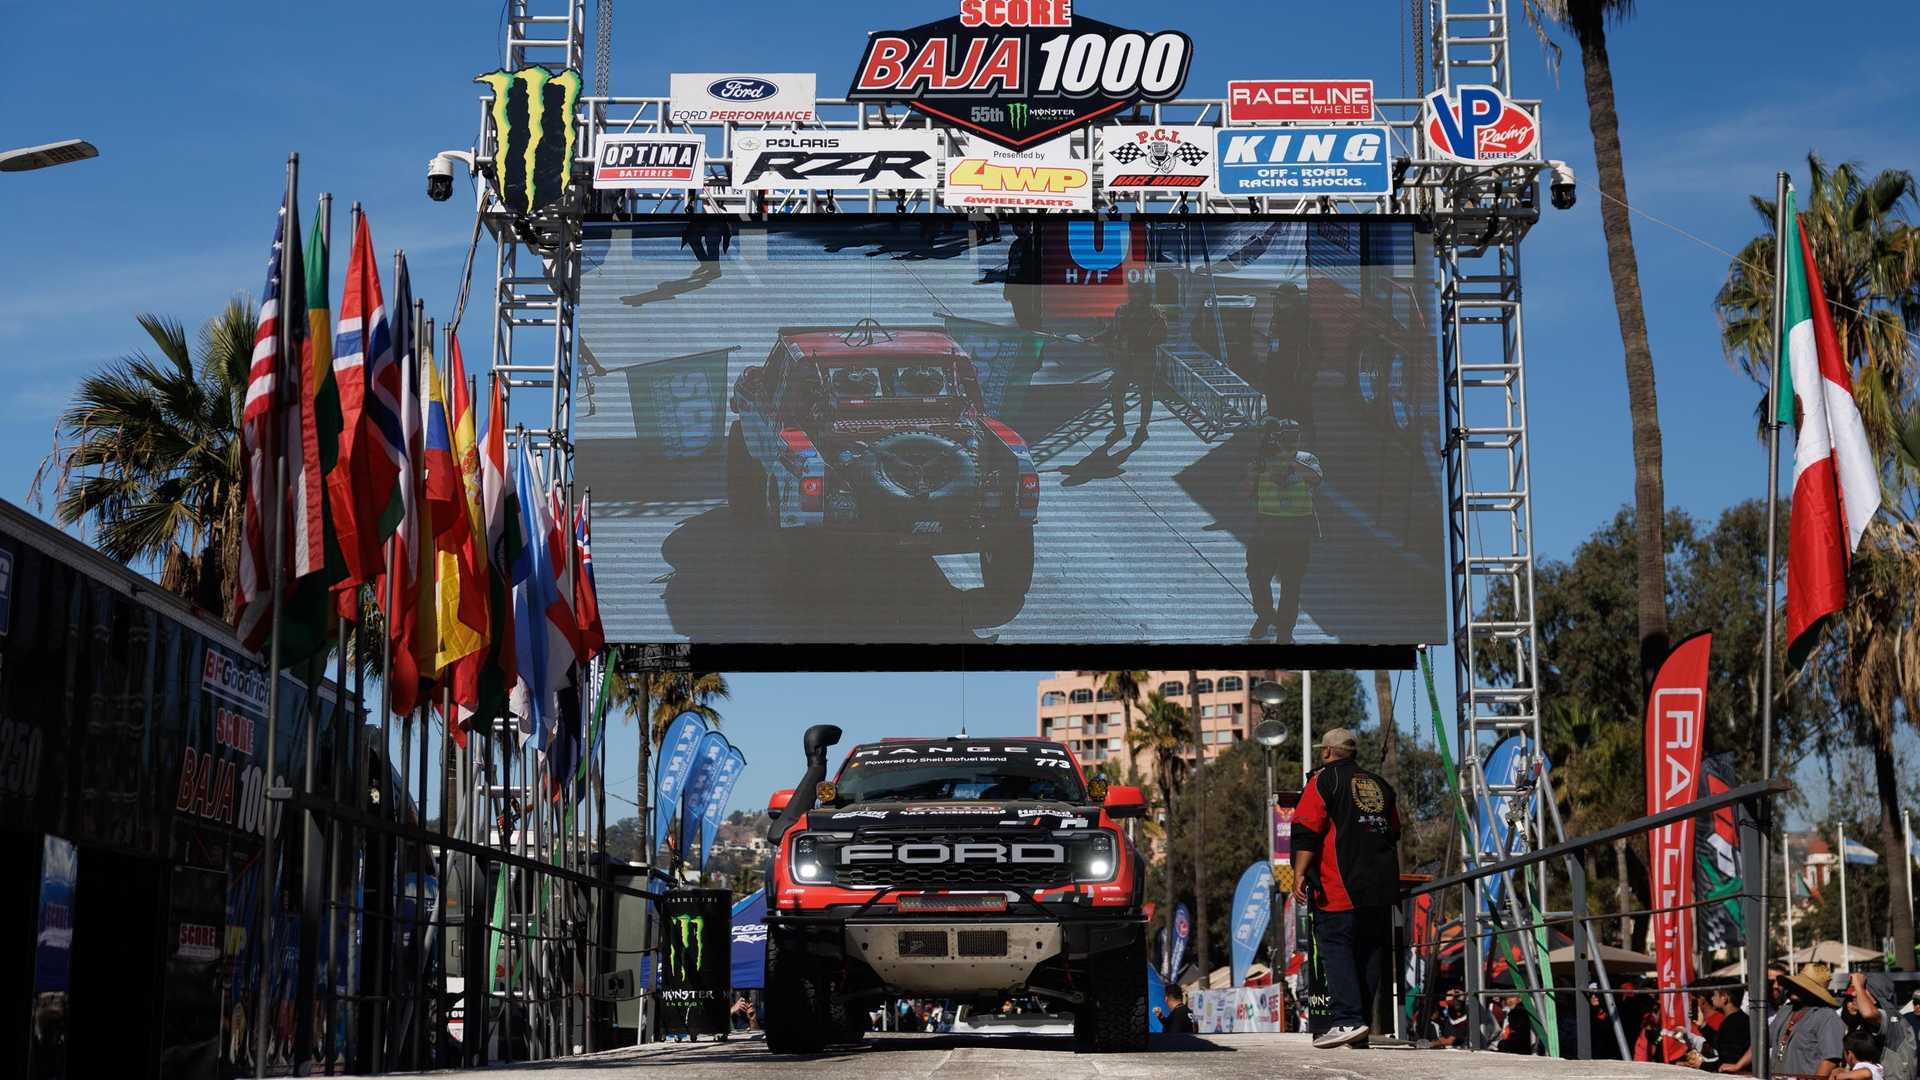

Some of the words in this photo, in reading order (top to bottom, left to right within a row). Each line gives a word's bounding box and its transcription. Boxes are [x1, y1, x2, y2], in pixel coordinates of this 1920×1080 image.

[960, 0, 1072, 27] SCORE
[857, 37, 1021, 91] BAJA
[1038, 33, 1186, 92] 1000
[721, 81, 764, 98] Ford
[1233, 87, 1370, 105] RACELINE
[672, 111, 707, 120] FORD
[709, 111, 813, 121] PERFORMANCE
[971, 106, 1004, 122] 55th
[1029, 109, 1076, 117] MONSTER
[1311, 105, 1369, 115] WHEELS
[1433, 87, 1501, 160] VP
[766, 138, 839, 149] POLARIS
[1480, 124, 1534, 151] Racing
[606, 145, 692, 166] OPTIMA
[993, 150, 1034, 159] Presented
[1035, 151, 1046, 160] by
[1224, 134, 1380, 163] KING
[619, 169, 673, 178] BATTERIES
[743, 151, 932, 185] RZR
[950, 159, 1088, 192] 4WP
[1114, 176, 1149, 186] RACE
[1151, 176, 1202, 186] RADIOS
[1239, 179, 1299, 188] RACING
[216, 707, 254, 755] SCORE
[864, 758, 906, 766] Powered
[1034, 757, 1071, 769] 773
[176, 745, 237, 825] BAJA
[841, 843, 1065, 864] FORD
